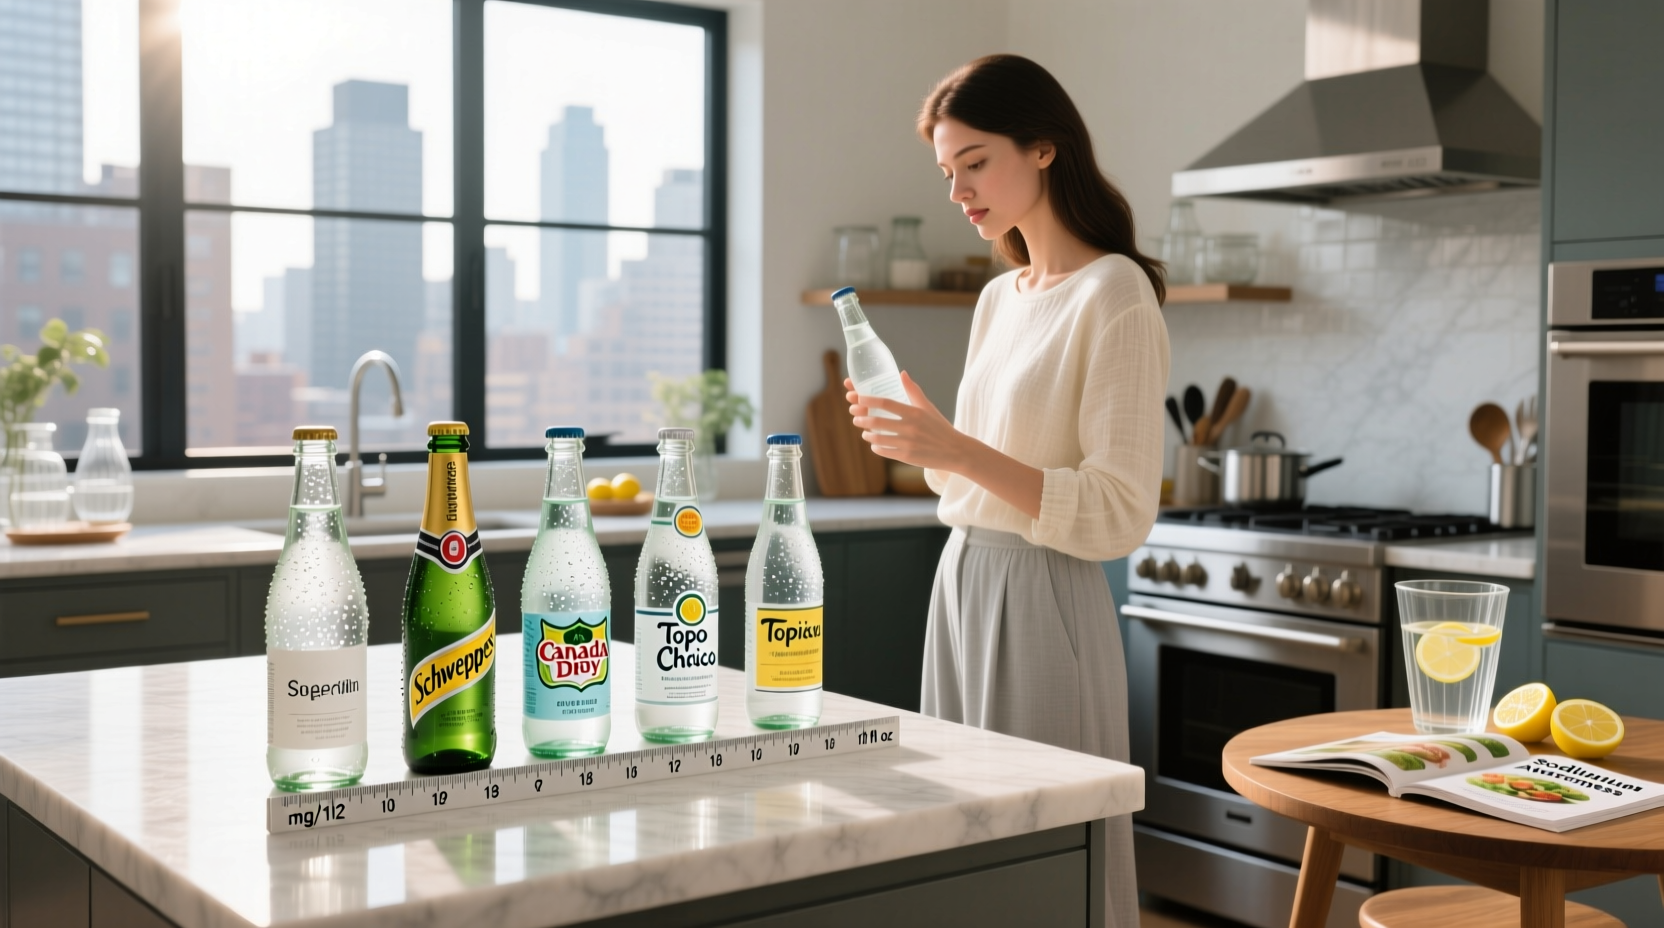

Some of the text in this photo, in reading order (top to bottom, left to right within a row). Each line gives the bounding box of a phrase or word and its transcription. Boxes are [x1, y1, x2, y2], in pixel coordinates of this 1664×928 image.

[657, 621, 708, 652] Topo
[381, 798, 396, 813] 10
[751, 748, 763, 762] 10
